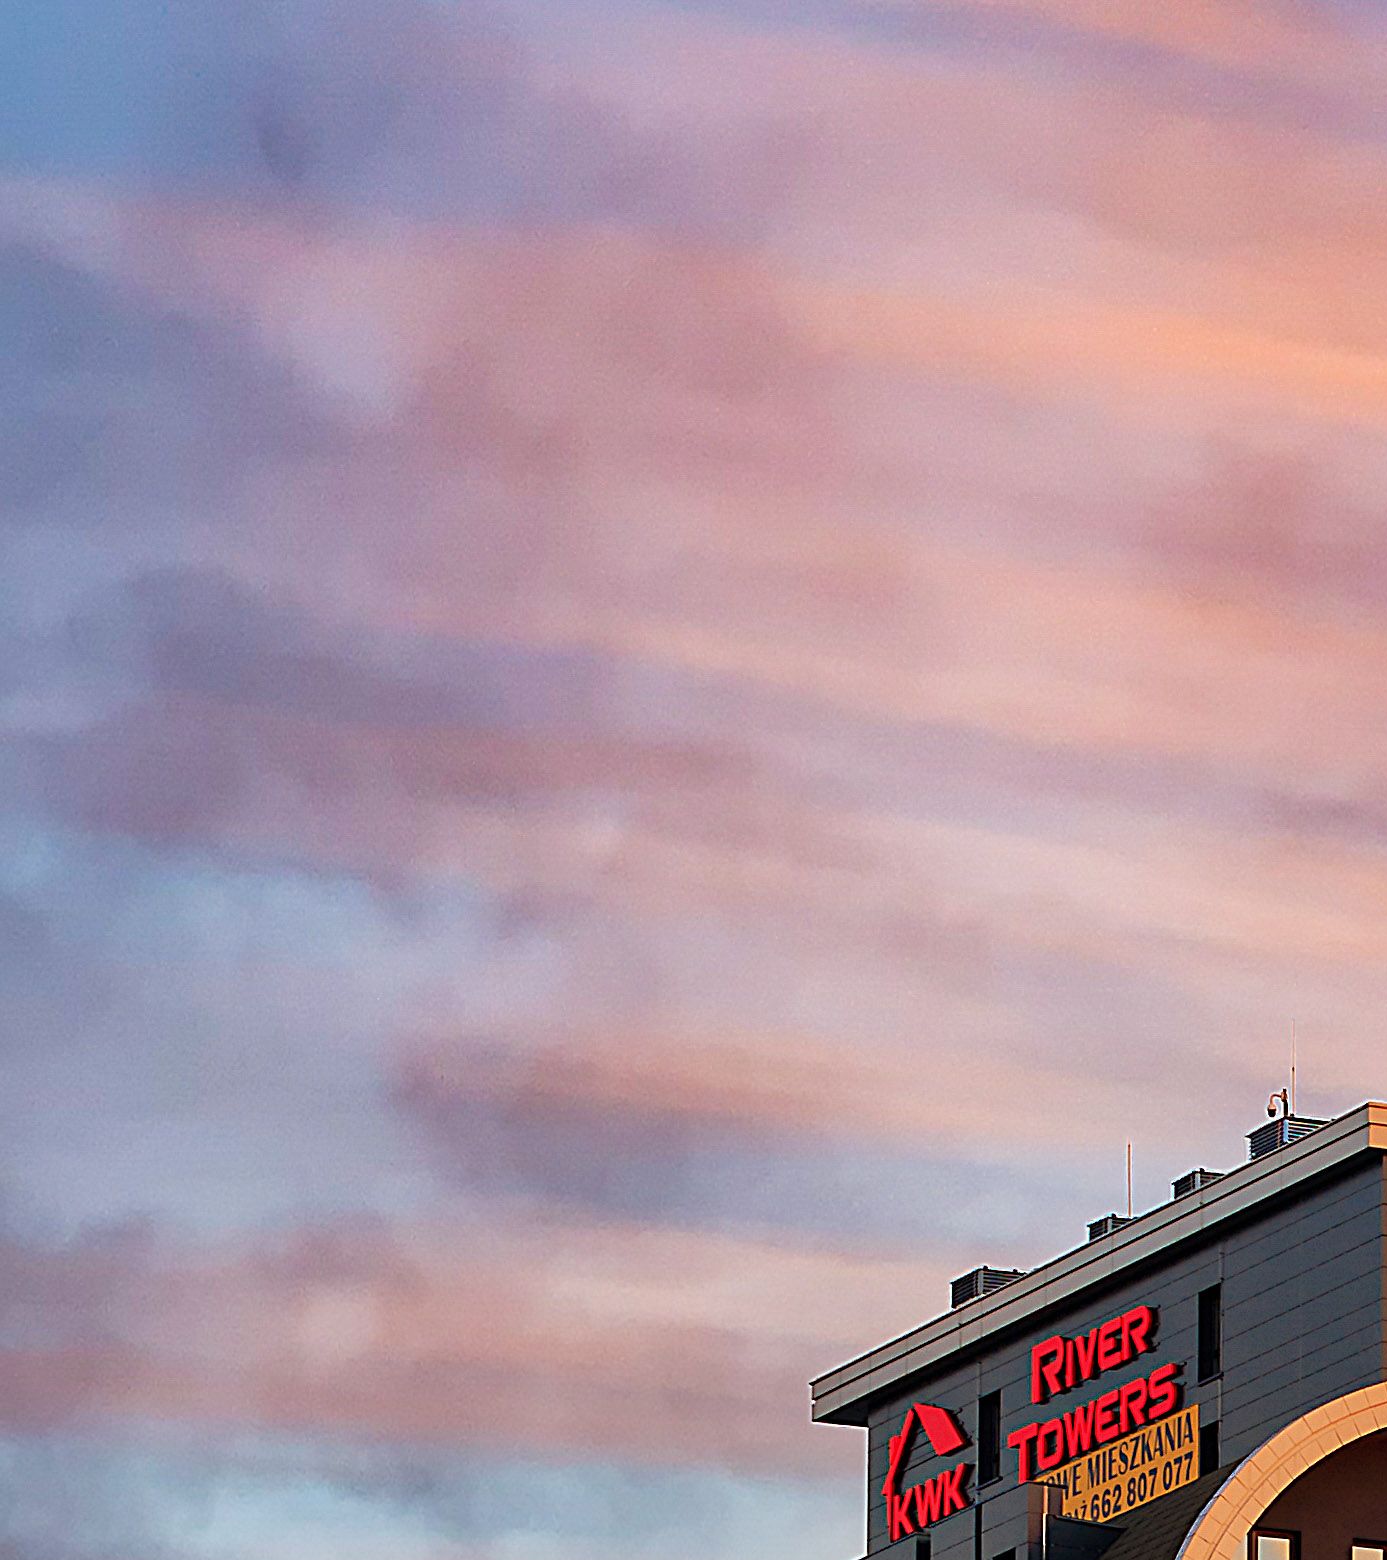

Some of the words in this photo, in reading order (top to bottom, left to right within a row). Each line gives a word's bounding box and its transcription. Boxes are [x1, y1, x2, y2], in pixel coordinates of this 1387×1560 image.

[1031, 1305, 1153, 1405] RIVER
[1007, 1363, 1178, 1484] TOWERS
[1087, 1412, 1193, 1490] MIESZKANIA
[889, 1463, 970, 1542] KWK
[1091, 1484, 1122, 1521] 662
[1126, 1468, 1158, 1506] 807
[1162, 1451, 1194, 1490] 077
